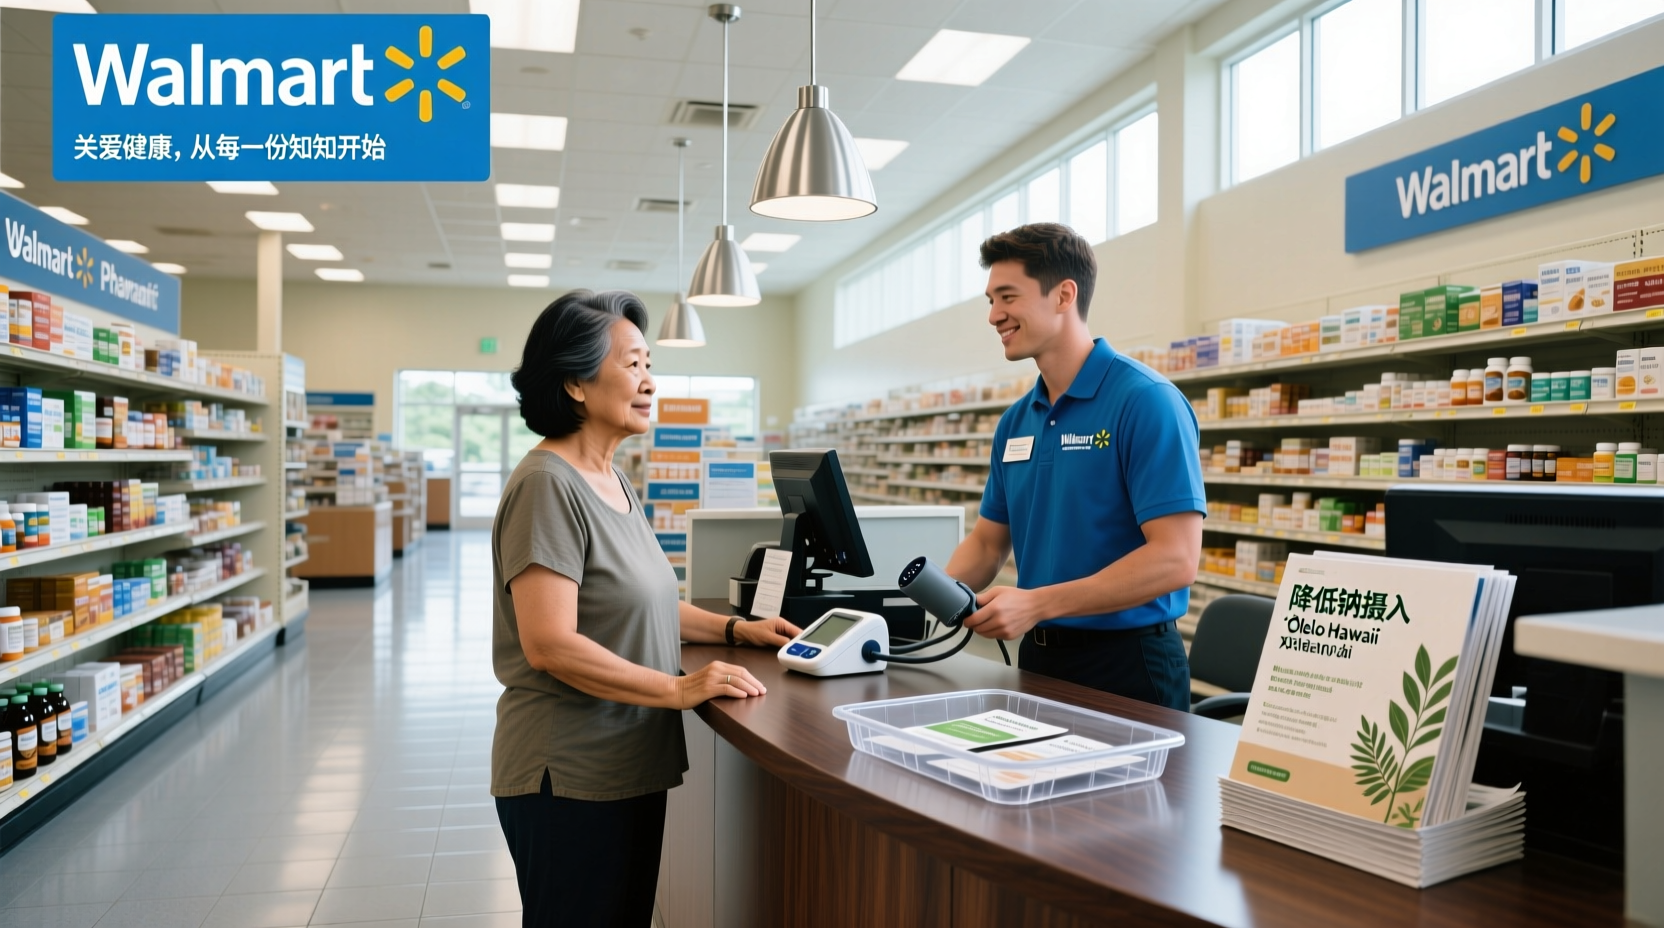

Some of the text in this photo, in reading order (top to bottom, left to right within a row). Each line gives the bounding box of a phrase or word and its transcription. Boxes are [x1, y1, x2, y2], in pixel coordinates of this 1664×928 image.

[1396, 131, 1552, 219] Walmart
[5, 217, 74, 279] Walmart
[1289, 584, 1410, 624] 降低钠摄入
[1328, 622, 1381, 645] Hawaii
